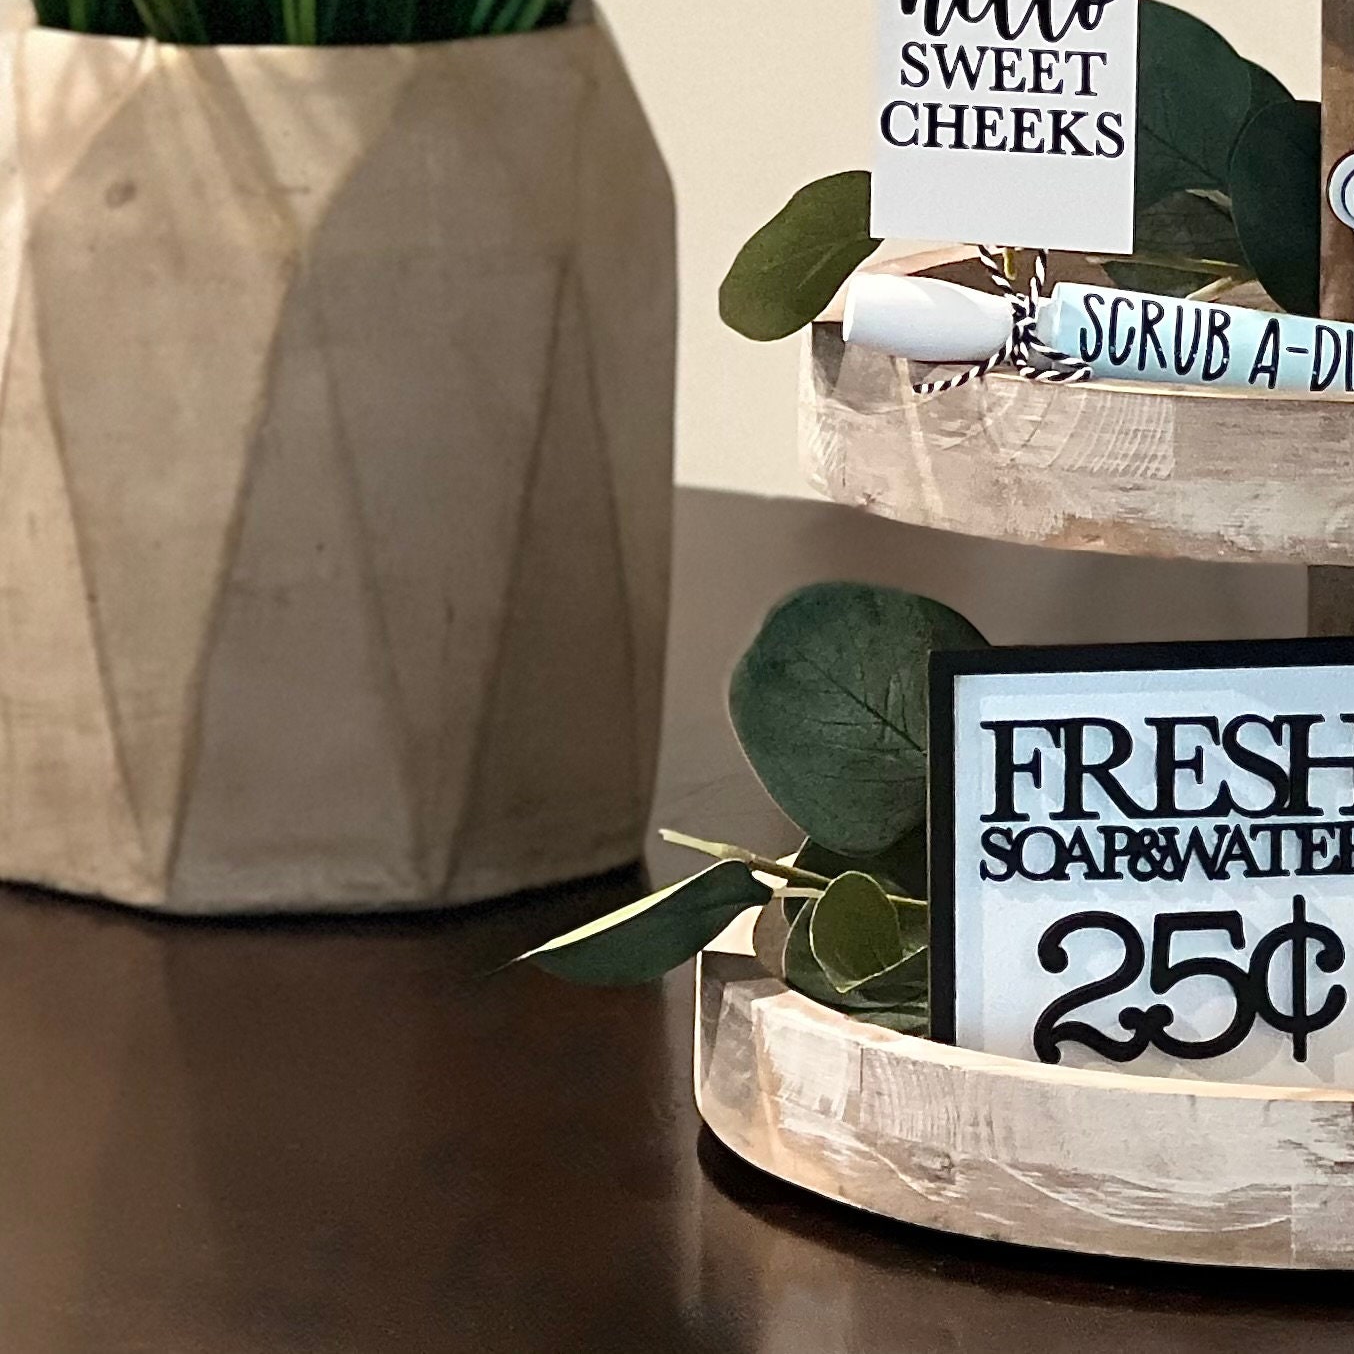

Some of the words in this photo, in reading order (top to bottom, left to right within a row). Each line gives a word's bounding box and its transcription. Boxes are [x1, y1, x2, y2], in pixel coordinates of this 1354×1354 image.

[900, 41, 1108, 97] SWEET
[880, 100, 1125, 159] CHEEKS
[1079, 292, 1232, 382] SCRUB
[1032, 894, 1347, 1064] 25¢
